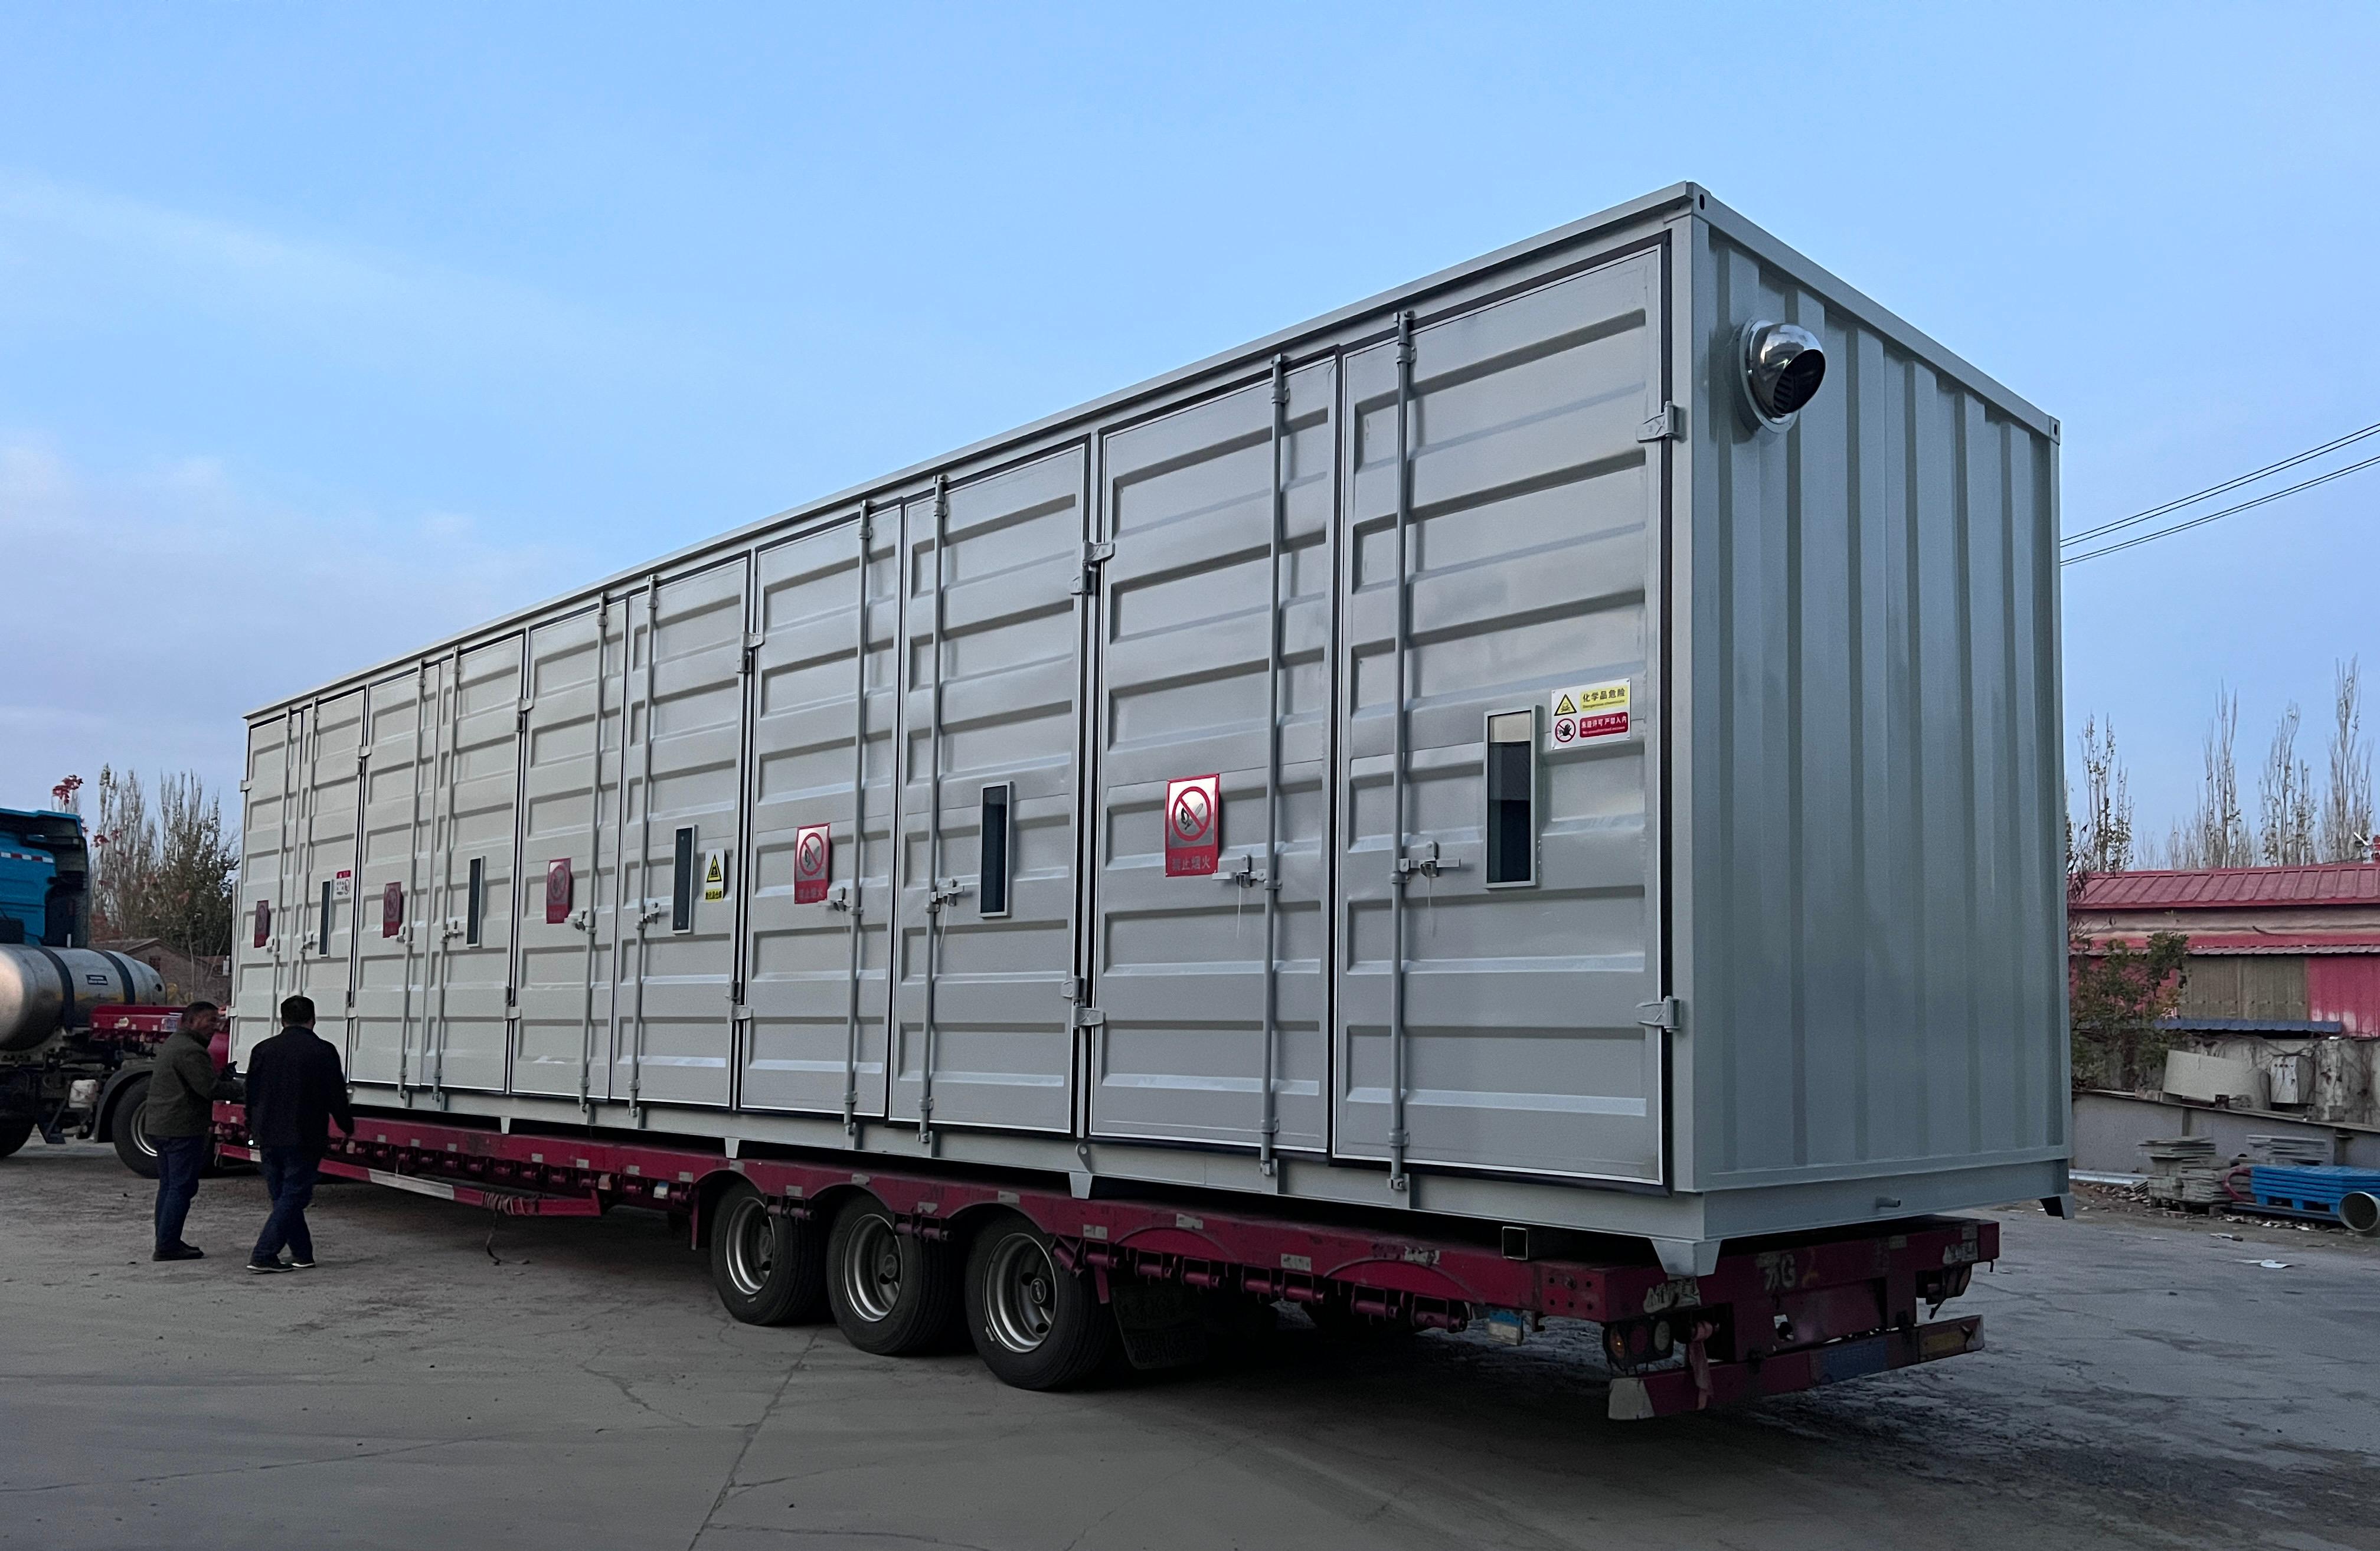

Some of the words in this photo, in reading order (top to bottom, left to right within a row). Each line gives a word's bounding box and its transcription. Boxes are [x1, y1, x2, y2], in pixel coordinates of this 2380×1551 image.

[1583, 688, 1625, 702] 化学品危险
